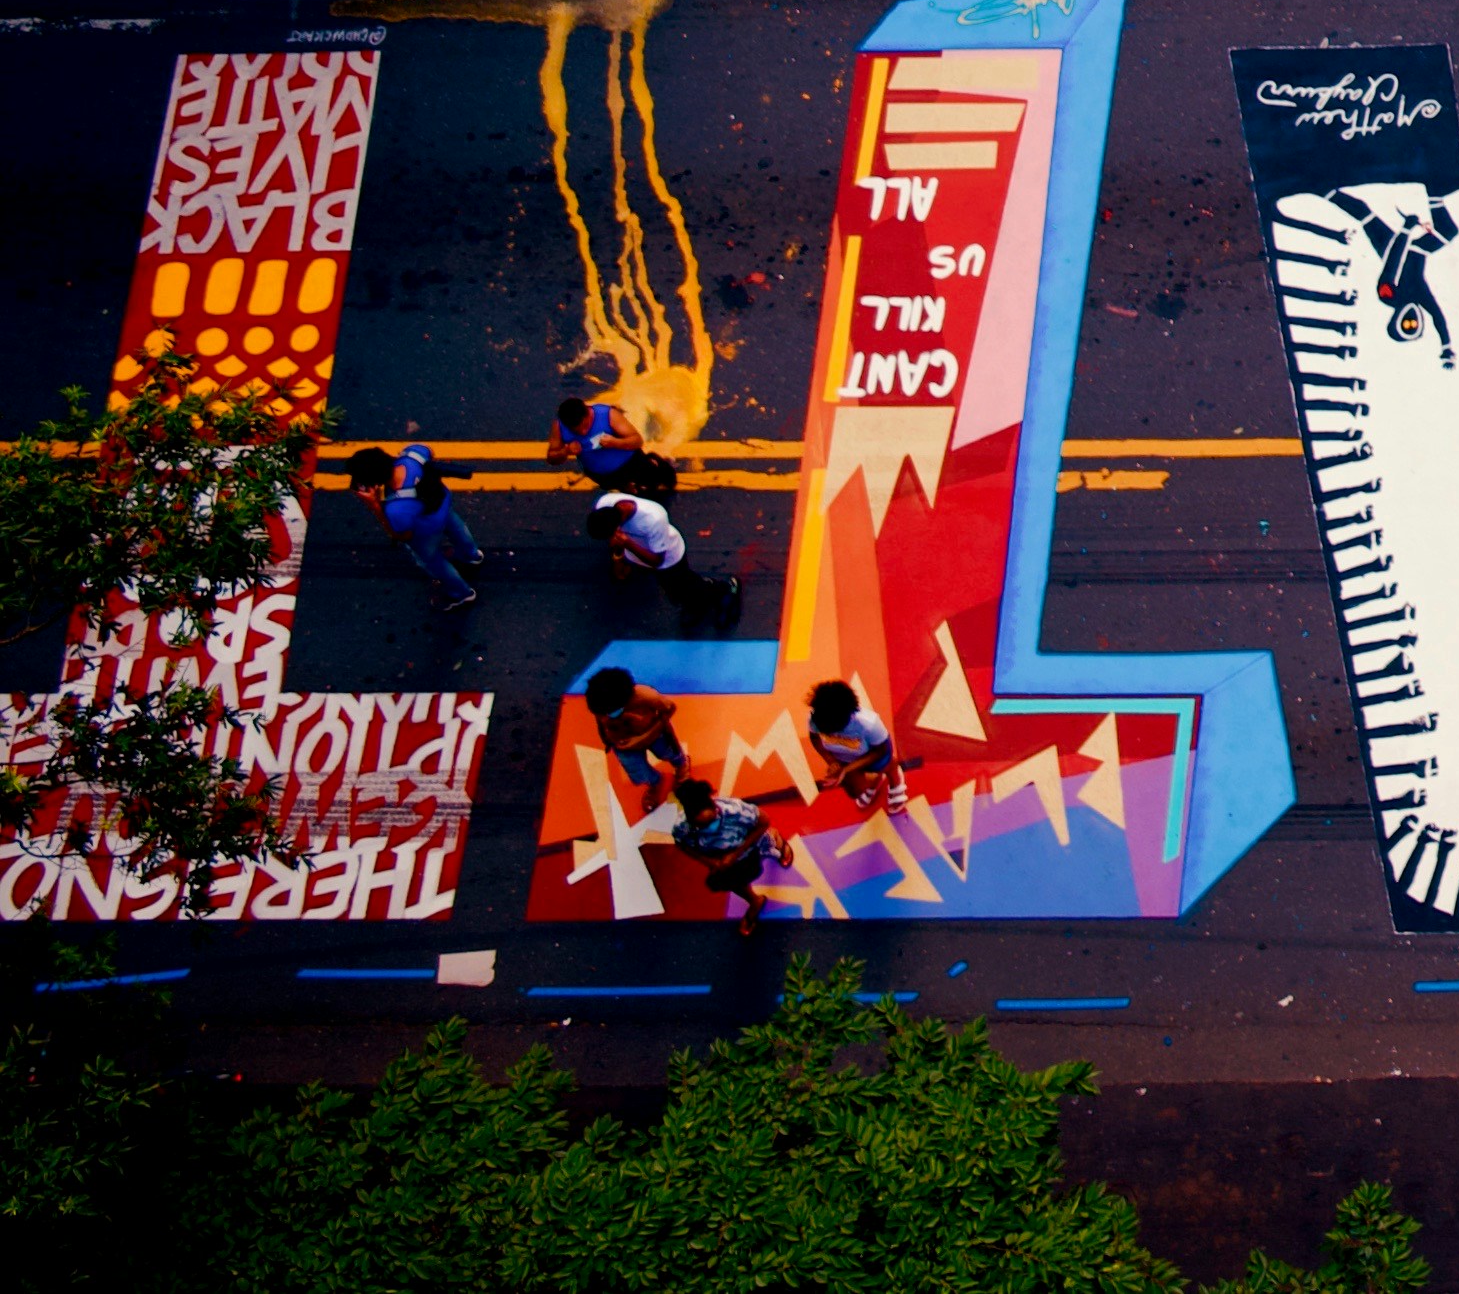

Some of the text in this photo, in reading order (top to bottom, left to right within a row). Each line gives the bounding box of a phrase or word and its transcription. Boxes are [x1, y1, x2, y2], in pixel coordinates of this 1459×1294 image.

[167, 129, 367, 196] LIVES
[137, 188, 357, 254] BLACK
[854, 175, 939, 222] ALL
[927, 243, 986, 280] US
[860, 295, 946, 333] KILL
[835, 348, 959, 398] CANT
